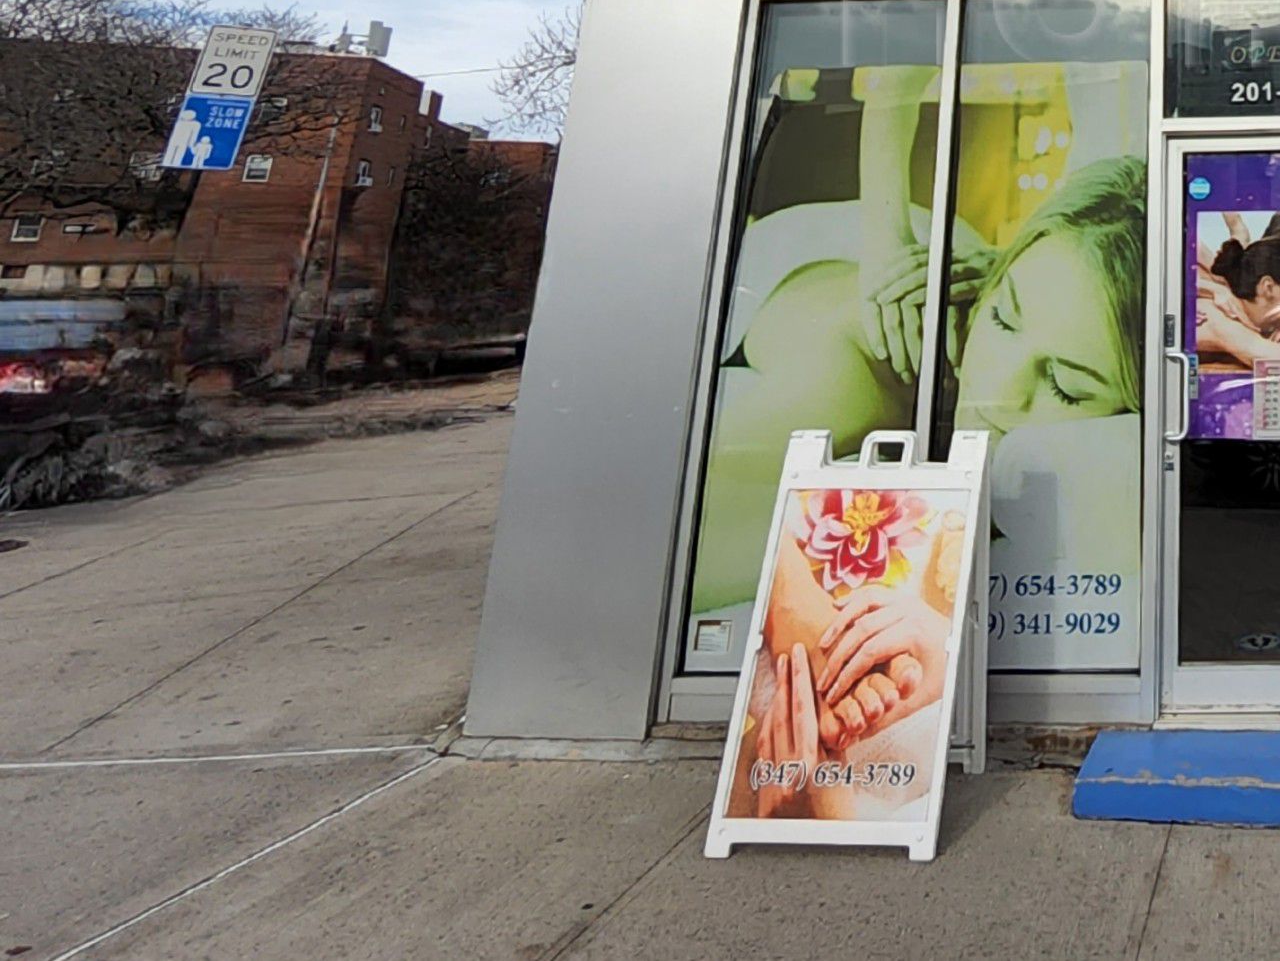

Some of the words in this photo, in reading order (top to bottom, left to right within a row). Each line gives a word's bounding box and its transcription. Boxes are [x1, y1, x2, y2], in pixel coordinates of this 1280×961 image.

[214, 31, 270, 46] SPEED
[214, 48, 261, 60] LIMIT
[201, 62, 254, 89] 20
[208, 105, 245, 118] SLOW
[204, 118, 242, 130] ZONE
[1015, 574, 1122, 596] 654-3789
[1013, 612, 1121, 634] 341-9029
[750, 760, 809, 791] (347)
[813, 761, 917, 787] 654-3789
